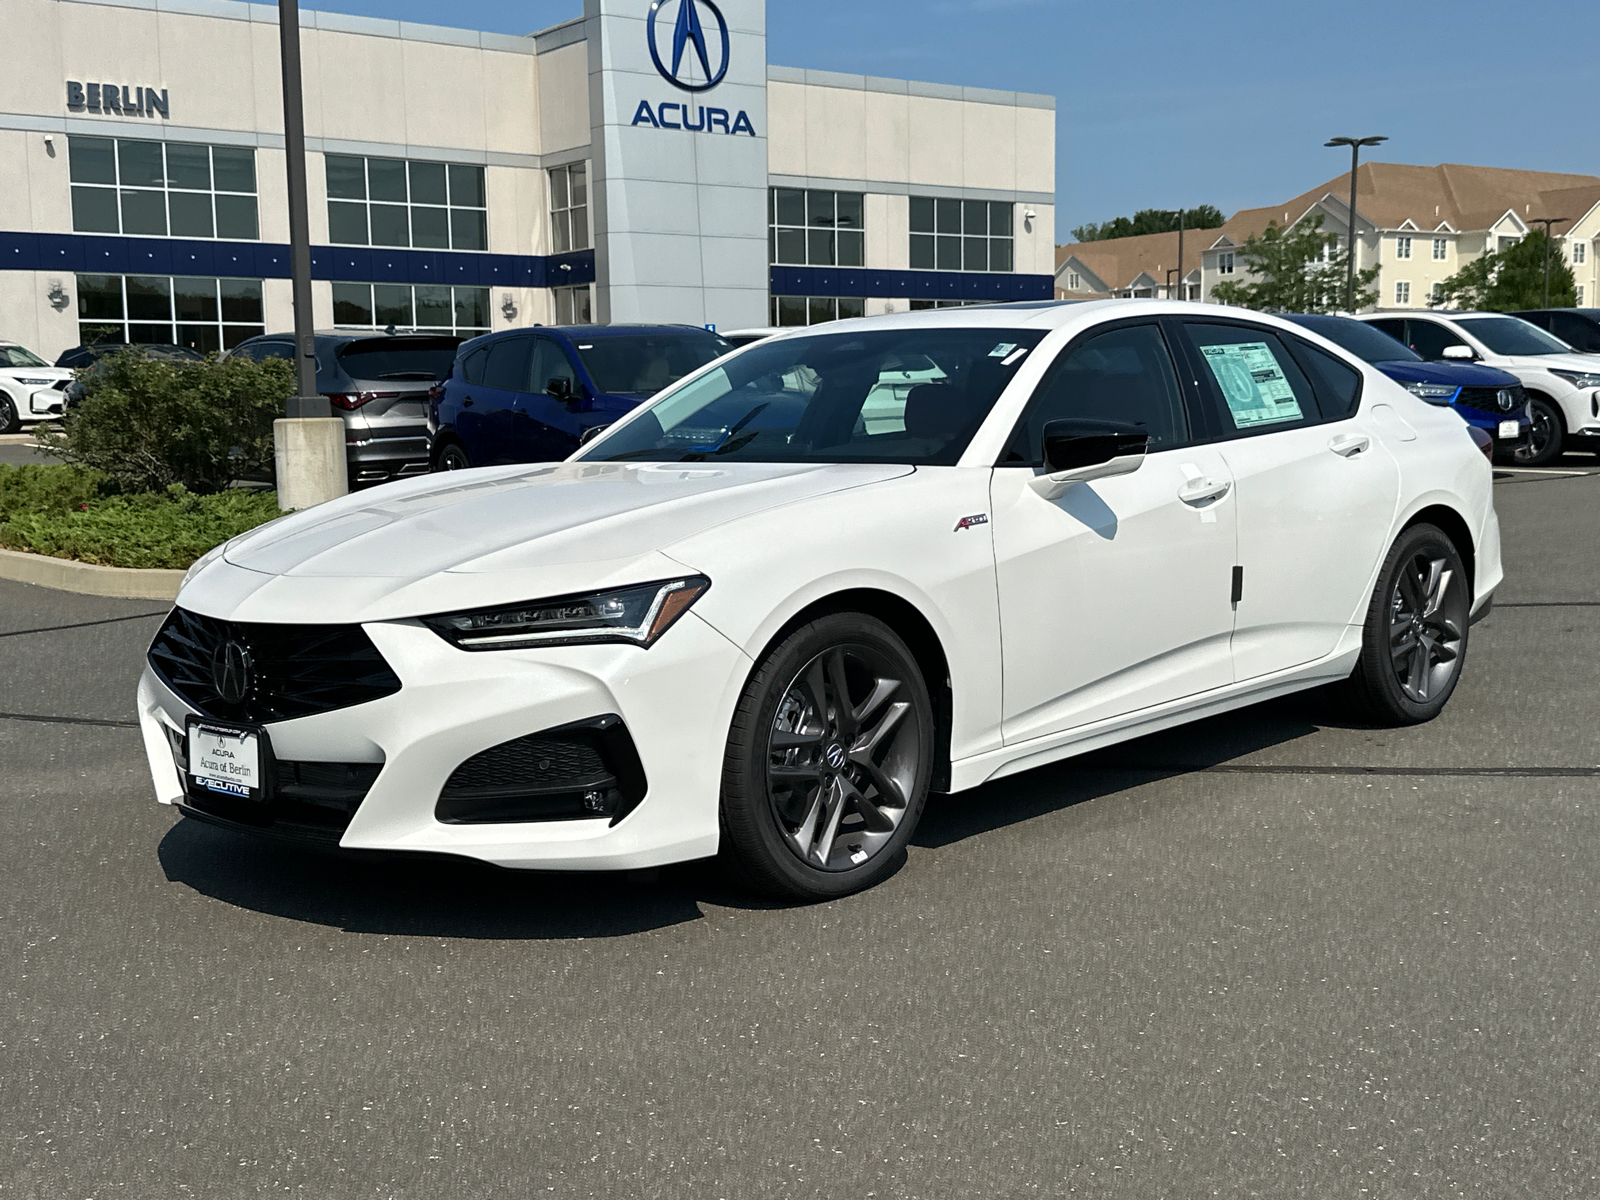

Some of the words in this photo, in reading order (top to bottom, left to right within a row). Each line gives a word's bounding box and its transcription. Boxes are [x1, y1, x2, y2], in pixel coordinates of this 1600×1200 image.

[67, 81, 169, 116] BERLIN
[631, 100, 756, 137] ACURA
[212, 748, 235, 759] ACURA
[200, 756, 219, 771] Acura
[219, 762, 228, 773] of
[229, 762, 252, 777] Berlin
[195, 776, 250, 795] EXECUTIVE
